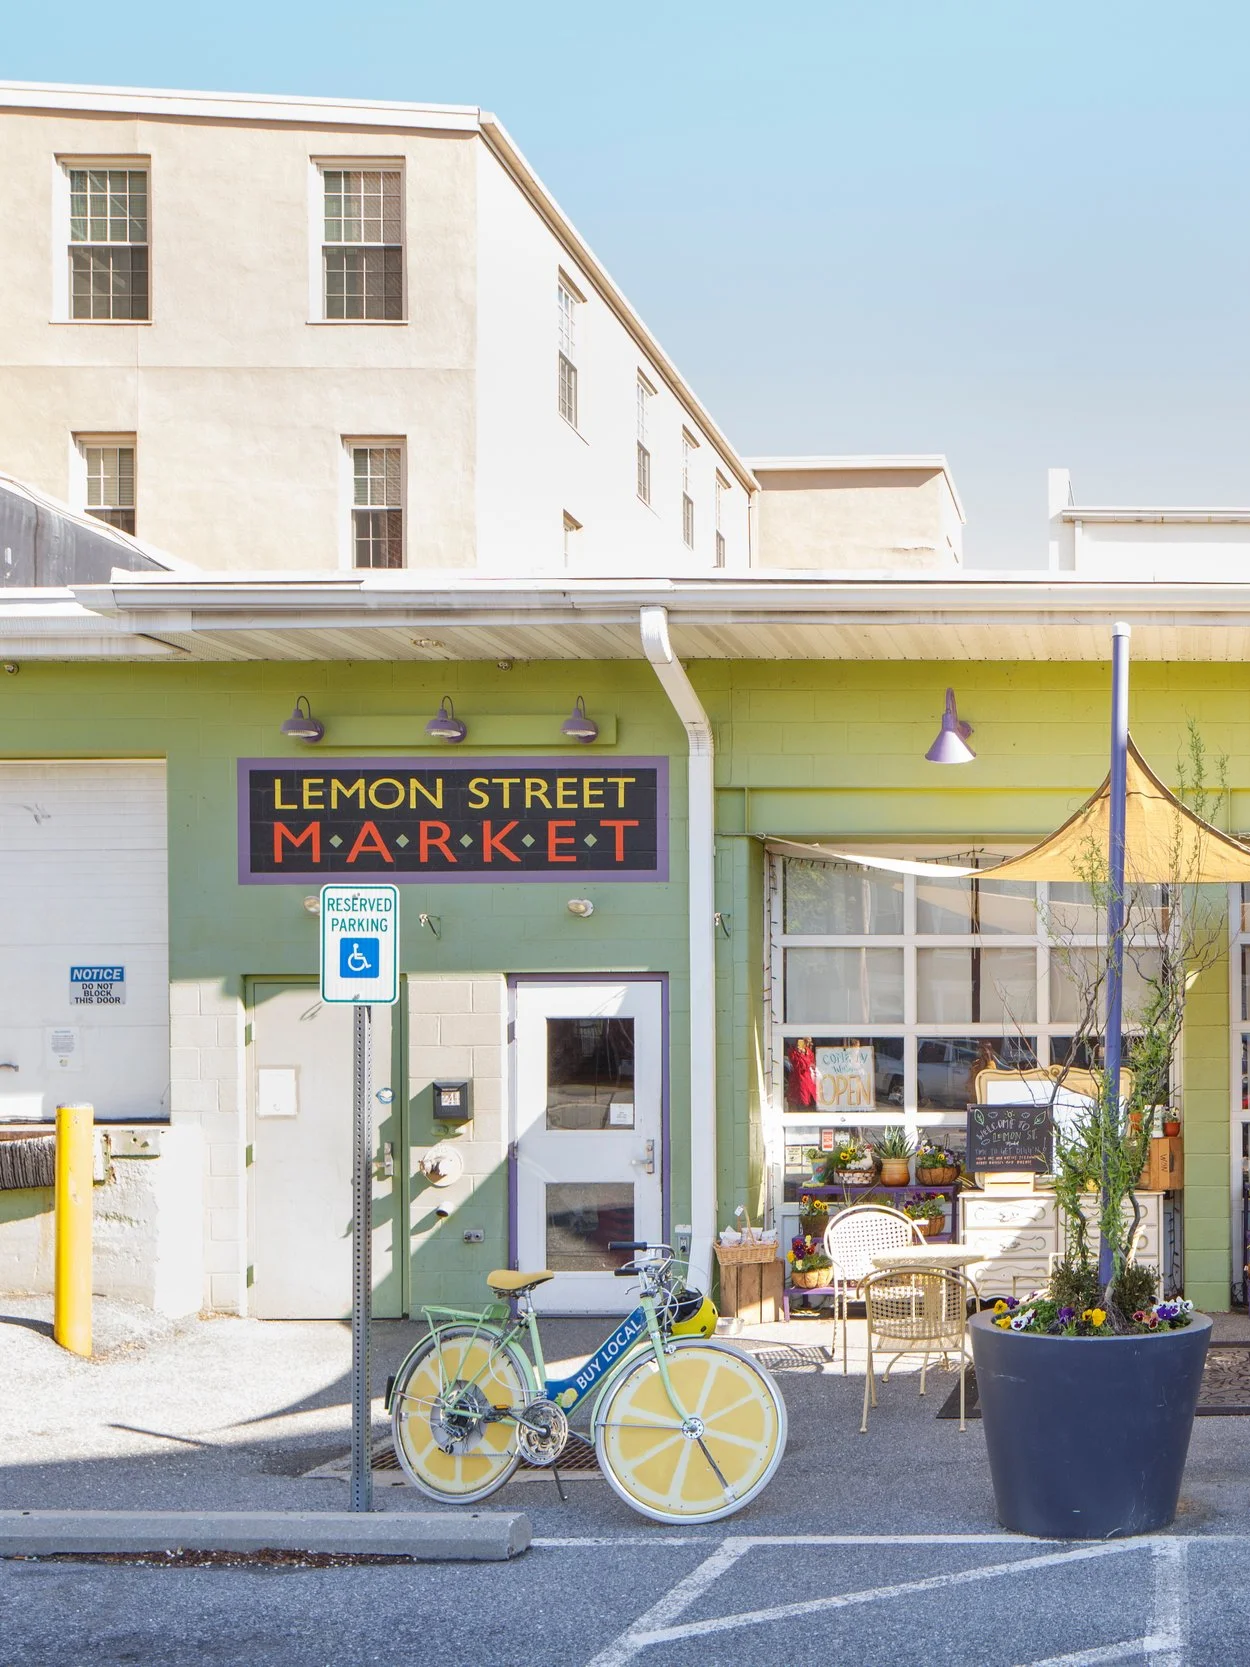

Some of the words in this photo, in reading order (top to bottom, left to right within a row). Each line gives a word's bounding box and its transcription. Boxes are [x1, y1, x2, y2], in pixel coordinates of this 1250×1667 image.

[274, 778, 443, 810] LEMON
[468, 777, 635, 809] STREET
[327, 897, 392, 912] RESERVED
[331, 918, 388, 932] PARKING
[72, 968, 122, 980] NOTICE
[819, 1072, 871, 1106] OPEN
[976, 1118, 1016, 1140] WELCOME
[1018, 1120, 1030, 1131] TO
[992, 1131, 1022, 1143] LEMON
[576, 1358, 601, 1390] BUY
[601, 1320, 641, 1363] LOCAL
